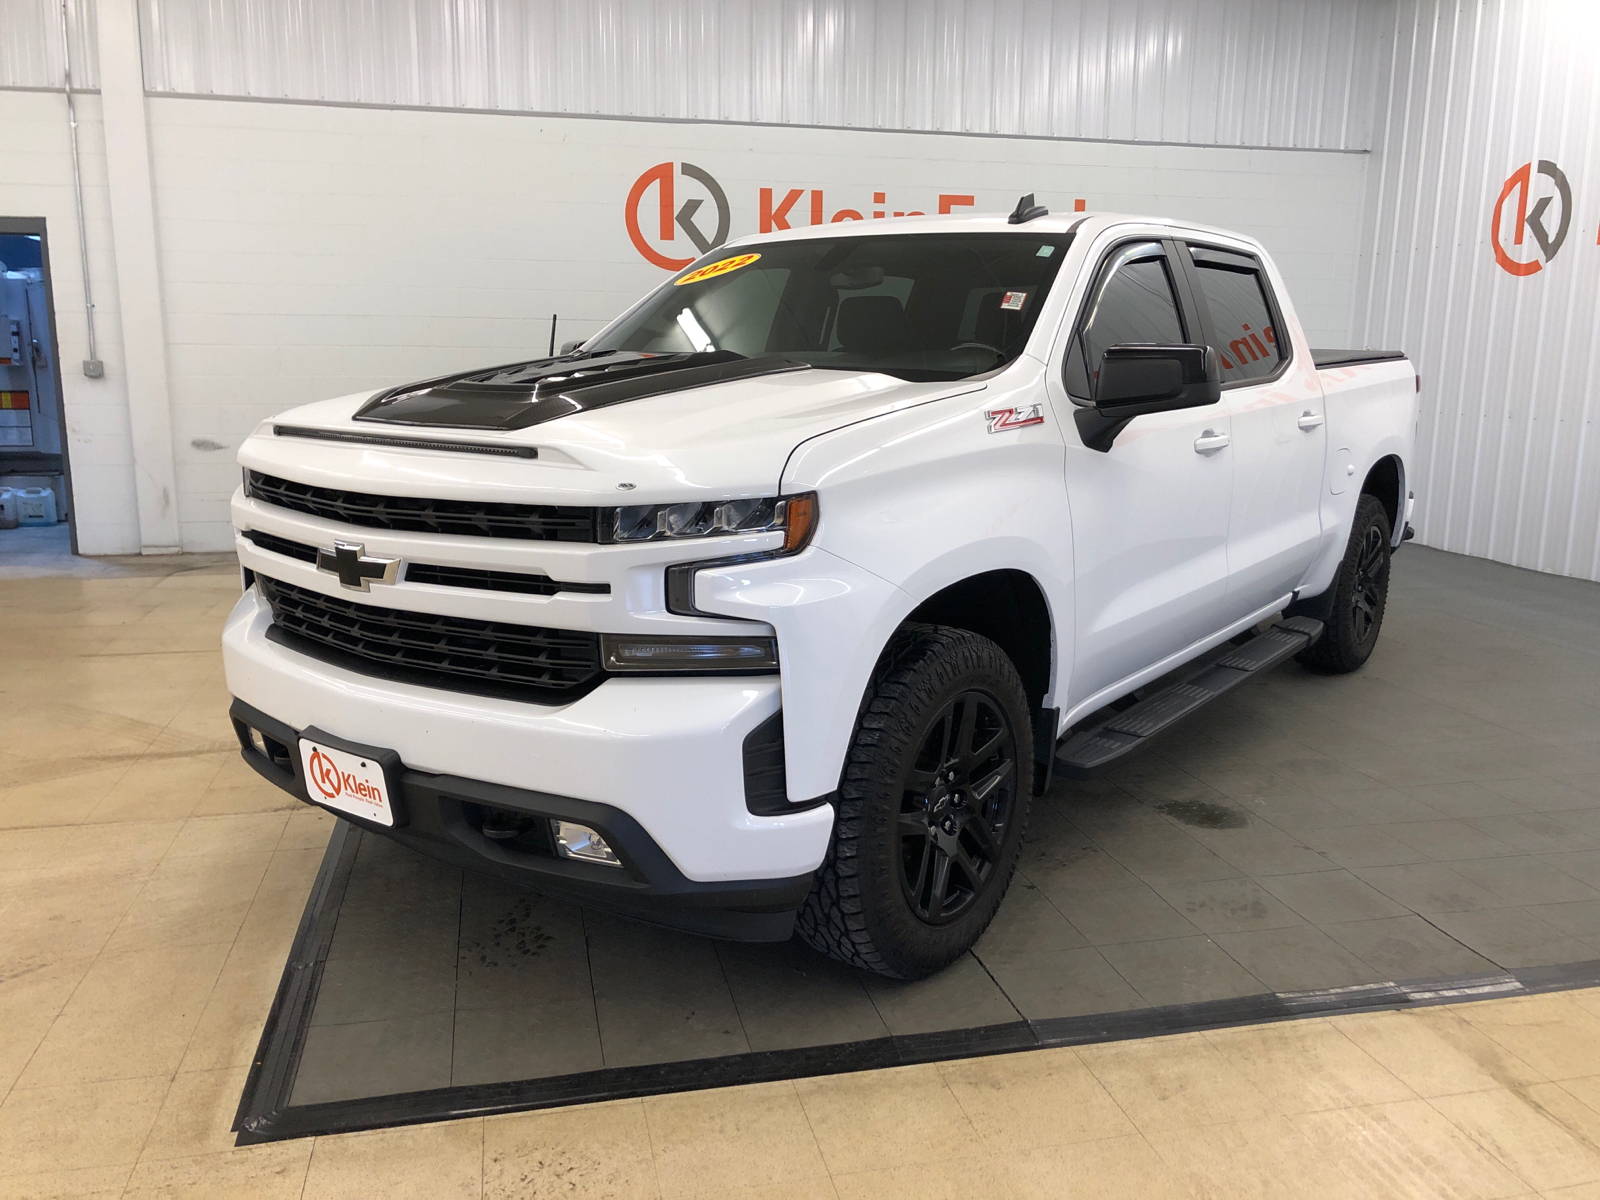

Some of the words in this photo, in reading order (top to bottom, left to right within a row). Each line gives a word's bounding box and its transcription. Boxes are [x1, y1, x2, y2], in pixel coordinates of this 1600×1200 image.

[681, 255, 755, 284] 2022
[984, 403, 1044, 434] Z71
[341, 771, 383, 803] Klein
